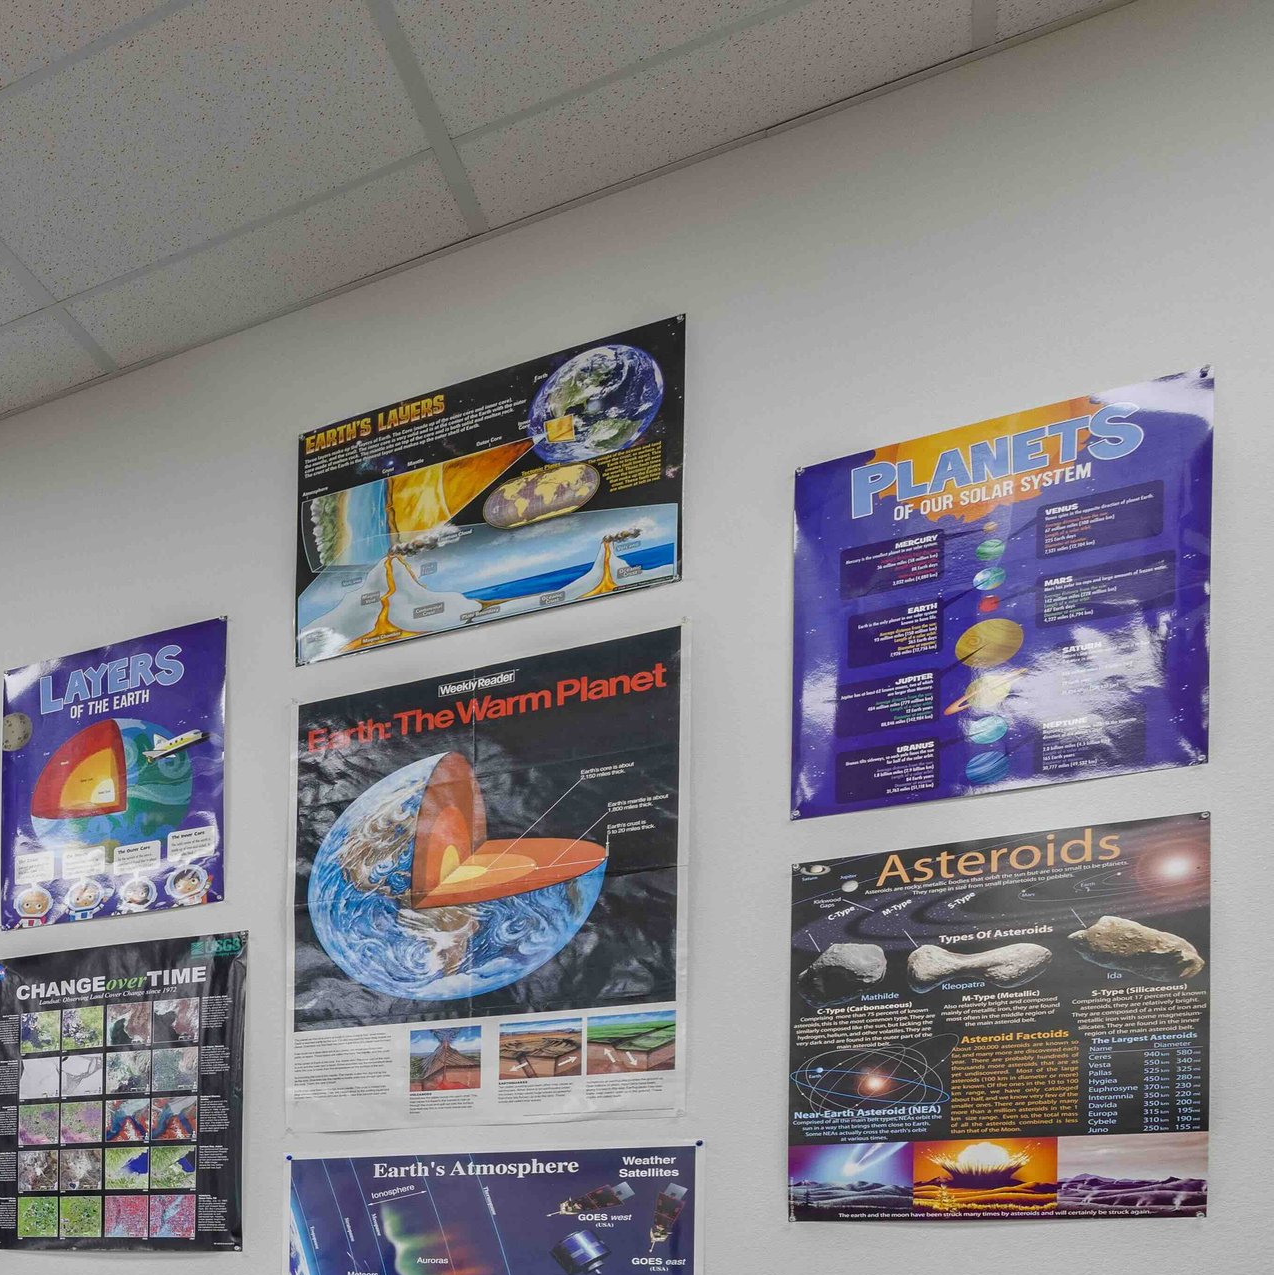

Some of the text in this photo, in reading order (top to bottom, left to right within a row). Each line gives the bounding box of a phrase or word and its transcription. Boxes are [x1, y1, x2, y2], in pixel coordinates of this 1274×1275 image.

[534, 373, 548, 383] Earth
[305, 394, 445, 454] EARTH'S LAYERS
[476, 439, 488, 447] Outer
[407, 458, 424, 467] Mantle
[851, 402, 1145, 520] PLANETS
[303, 486, 328, 497] Atmosphere
[894, 463, 1092, 522] OF OUR SOLAR SYSTEM
[1045, 503, 1078, 515] VENUS
[895, 534, 938, 549] MERCURY
[1044, 576, 1073, 586] MARS
[908, 603, 937, 614] EARTH
[1062, 642, 1102, 654] SATURN
[40, 645, 184, 714] LAYERS
[440, 672, 514, 696] Weekly Reader
[895, 673, 933, 685] JUPITER
[70, 689, 149, 718] OF THE EARTH
[307, 663, 666, 753] Earth: The Warm Planet
[1043, 717, 1088, 729] NEPTUNE
[897, 741, 934, 753] URANUS
[876, 828, 1121, 887] Asteroids
[939, 926, 1053, 944] Types Of Asteroids
[16, 966, 206, 1000] CHANGE over TIME
[942, 982, 985, 990] Kleopatra
[1127, 984, 1187, 994] (Silicaceous)
[63, 995, 89, 1004] Observing
[90, 992, 104, 1000] Land
[122, 988, 145, 997] Change
[861, 992, 899, 1001] Mathilde
[962, 990, 1040, 1002] M-Type (Metallic)
[847, 1002, 912, 1013] (Carbonaceous)
[961, 1030, 1069, 1044] Asteroid Factoids
[1112, 1036, 1147, 1044] Largest
[1151, 1032, 1197, 1041] Asteroids
[794, 1105, 941, 1119] Near-Earth Asteroid (NEA)
[622, 1156, 676, 1165] Weather
[374, 1158, 579, 1178] Earth's Atmosphere
[619, 1169, 679, 1178] Satellites
[371, 1184, 415, 1199] Ionosphere
